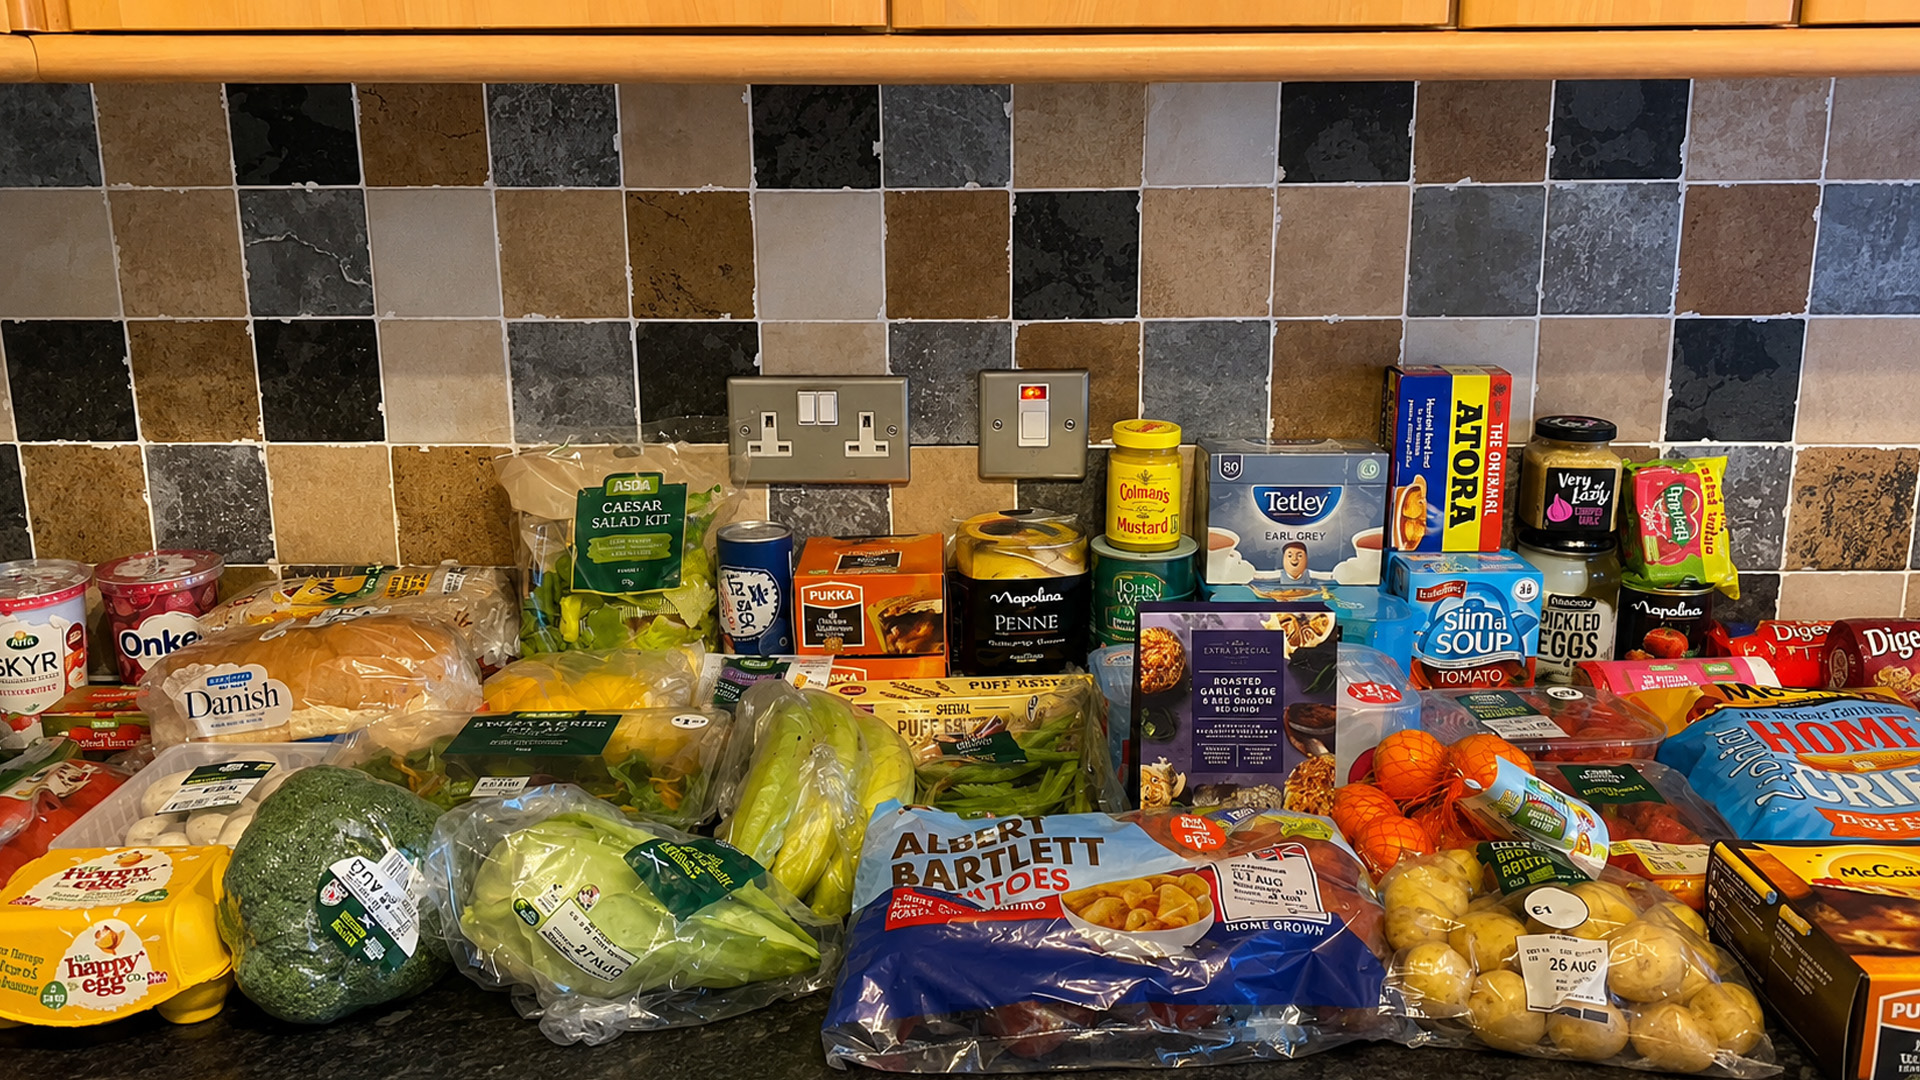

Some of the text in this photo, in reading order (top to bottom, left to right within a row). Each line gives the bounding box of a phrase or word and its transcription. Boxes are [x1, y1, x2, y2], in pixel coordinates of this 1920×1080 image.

[1489, 422, 1504, 448] THE
[1449, 400, 1484, 529] ATORA
[1558, 472, 1592, 491] Very
[1119, 482, 1170, 504] Colman's
[602, 499, 662, 514] CAESAR
[1264, 490, 1329, 517] Tetley
[592, 513, 671, 529] SALAD KIT
[1117, 516, 1168, 535] Mustard
[1265, 531, 1327, 541] EARL GREY
[810, 589, 855, 601] PUKKA
[990, 586, 1064, 607] Napolina
[1631, 600, 1703, 619] Napolina
[994, 614, 1059, 631] PENNE
[1540, 609, 1601, 632] PICKLED
[1435, 631, 1513, 655] SOUP
[1537, 628, 1599, 659] EGGS
[1213, 677, 1262, 686] ROASTED
[1438, 669, 1503, 684] TOMATO
[184, 681, 280, 720] Danish
[1200, 687, 1241, 696] GARLIC
[891, 816, 1045, 860] ALBERT
[891, 836, 1105, 892] BARTLETT
[1273, 920, 1325, 936] GROWN
[65, 950, 146, 979] happy
[1549, 957, 1597, 973] 26 AUG
[82, 975, 127, 997] egg
